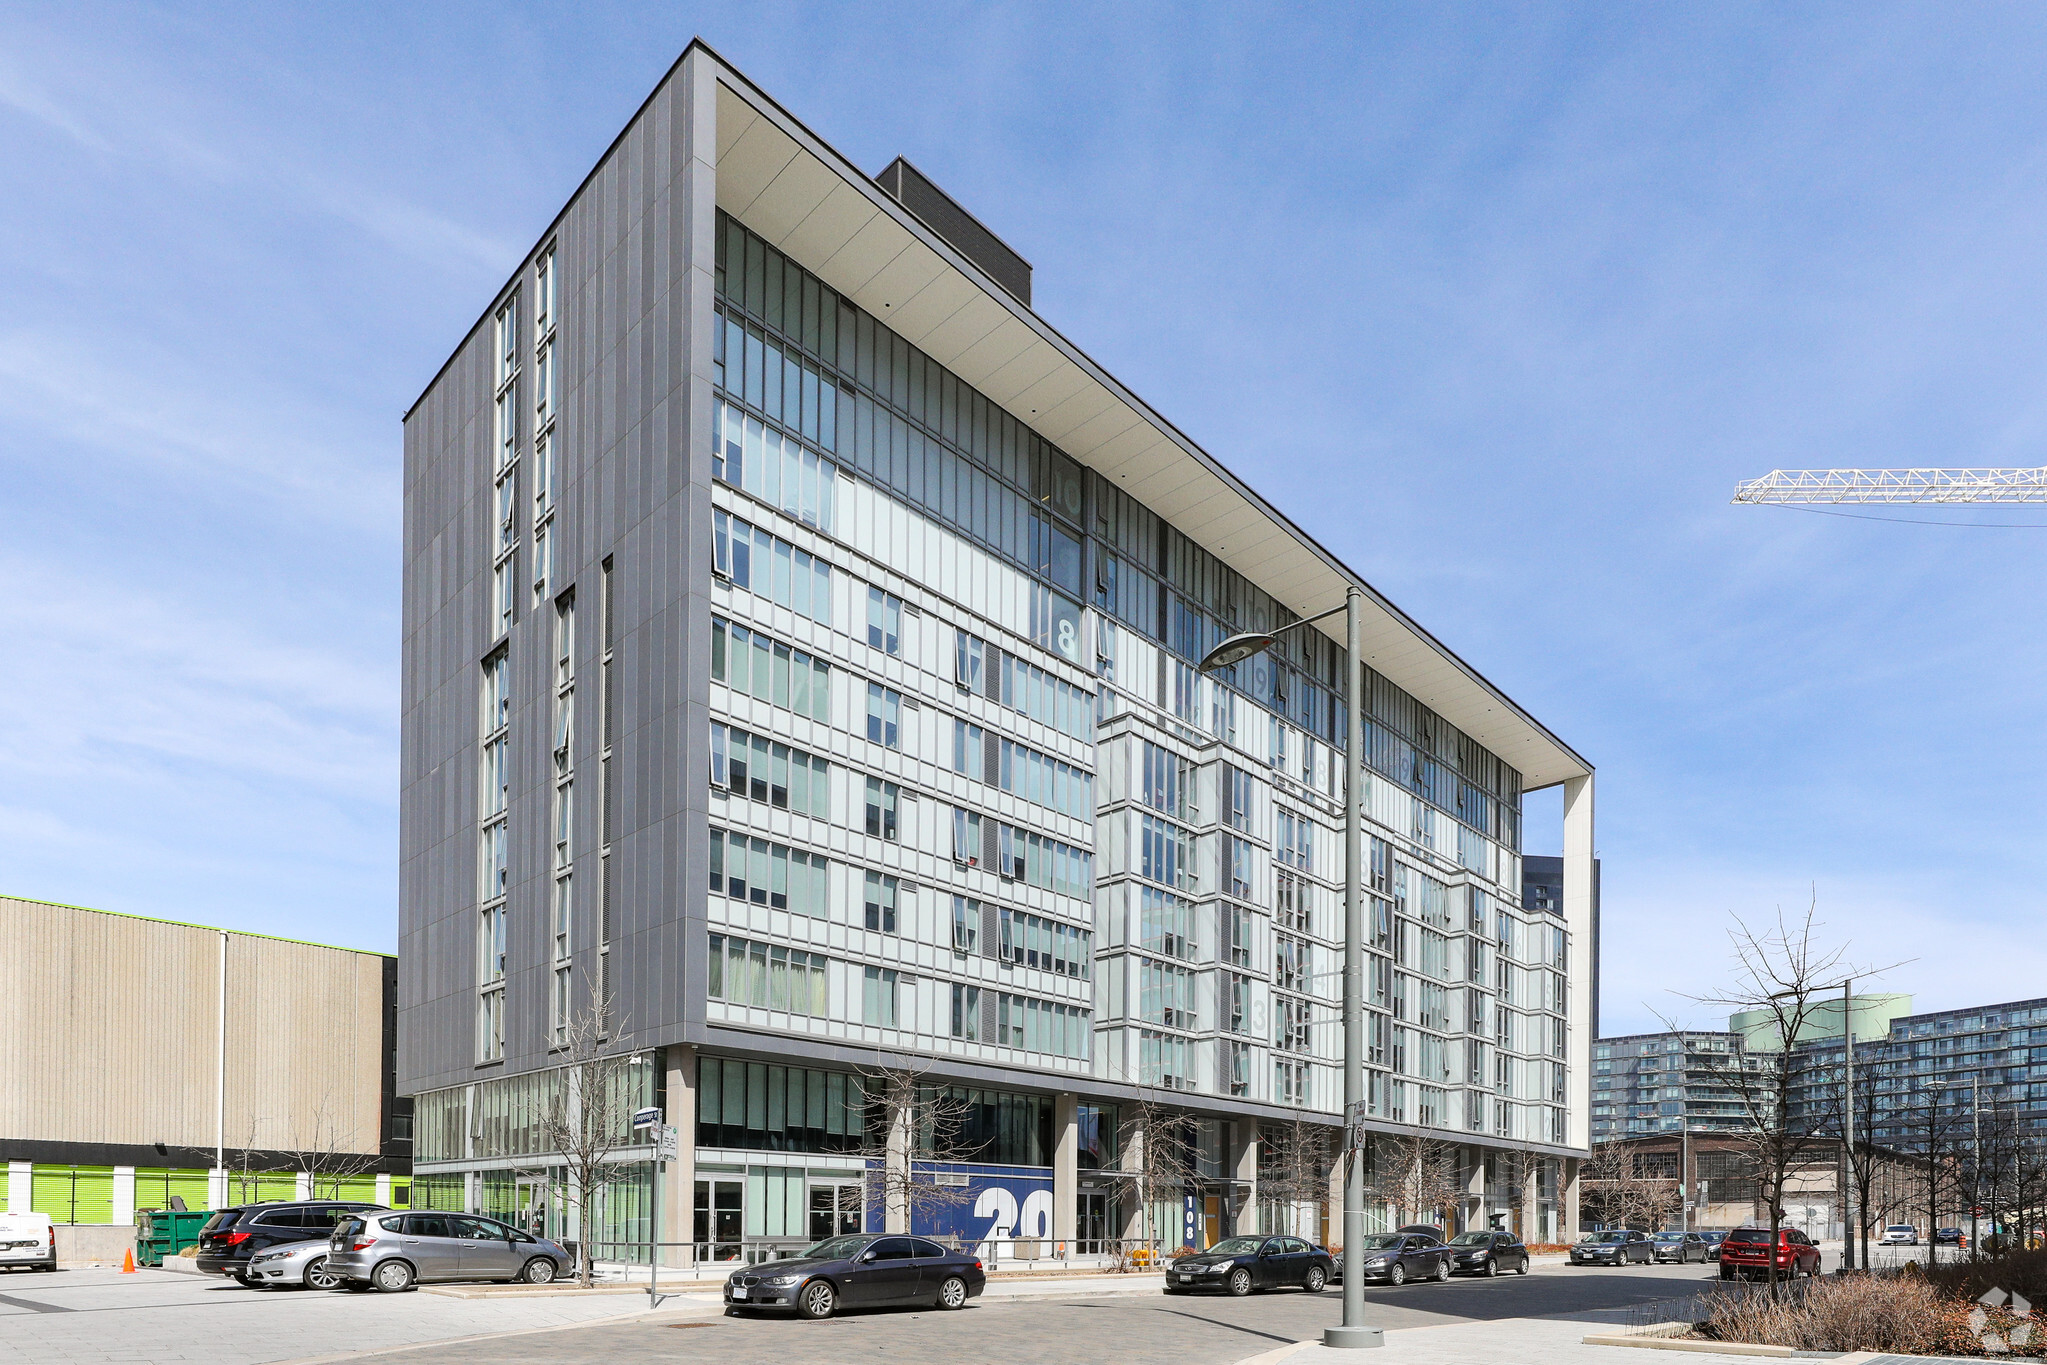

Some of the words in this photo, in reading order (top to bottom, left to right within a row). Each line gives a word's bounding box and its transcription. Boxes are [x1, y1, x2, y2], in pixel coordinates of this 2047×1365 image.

[1058, 618, 1075, 655] 8
[1255, 666, 1267, 695] 9
[1316, 759, 1326, 787] 8
[1401, 757, 1410, 781] 9
[1500, 862, 1507, 883] 8
[1515, 936, 1522, 957] 6
[1314, 964, 1326, 992] 4
[1253, 999, 1266, 1031] 3
[1486, 1010, 1494, 1030] 4
[1544, 1116, 1552, 1138] 2
[973, 1187, 1053, 1258] 20
